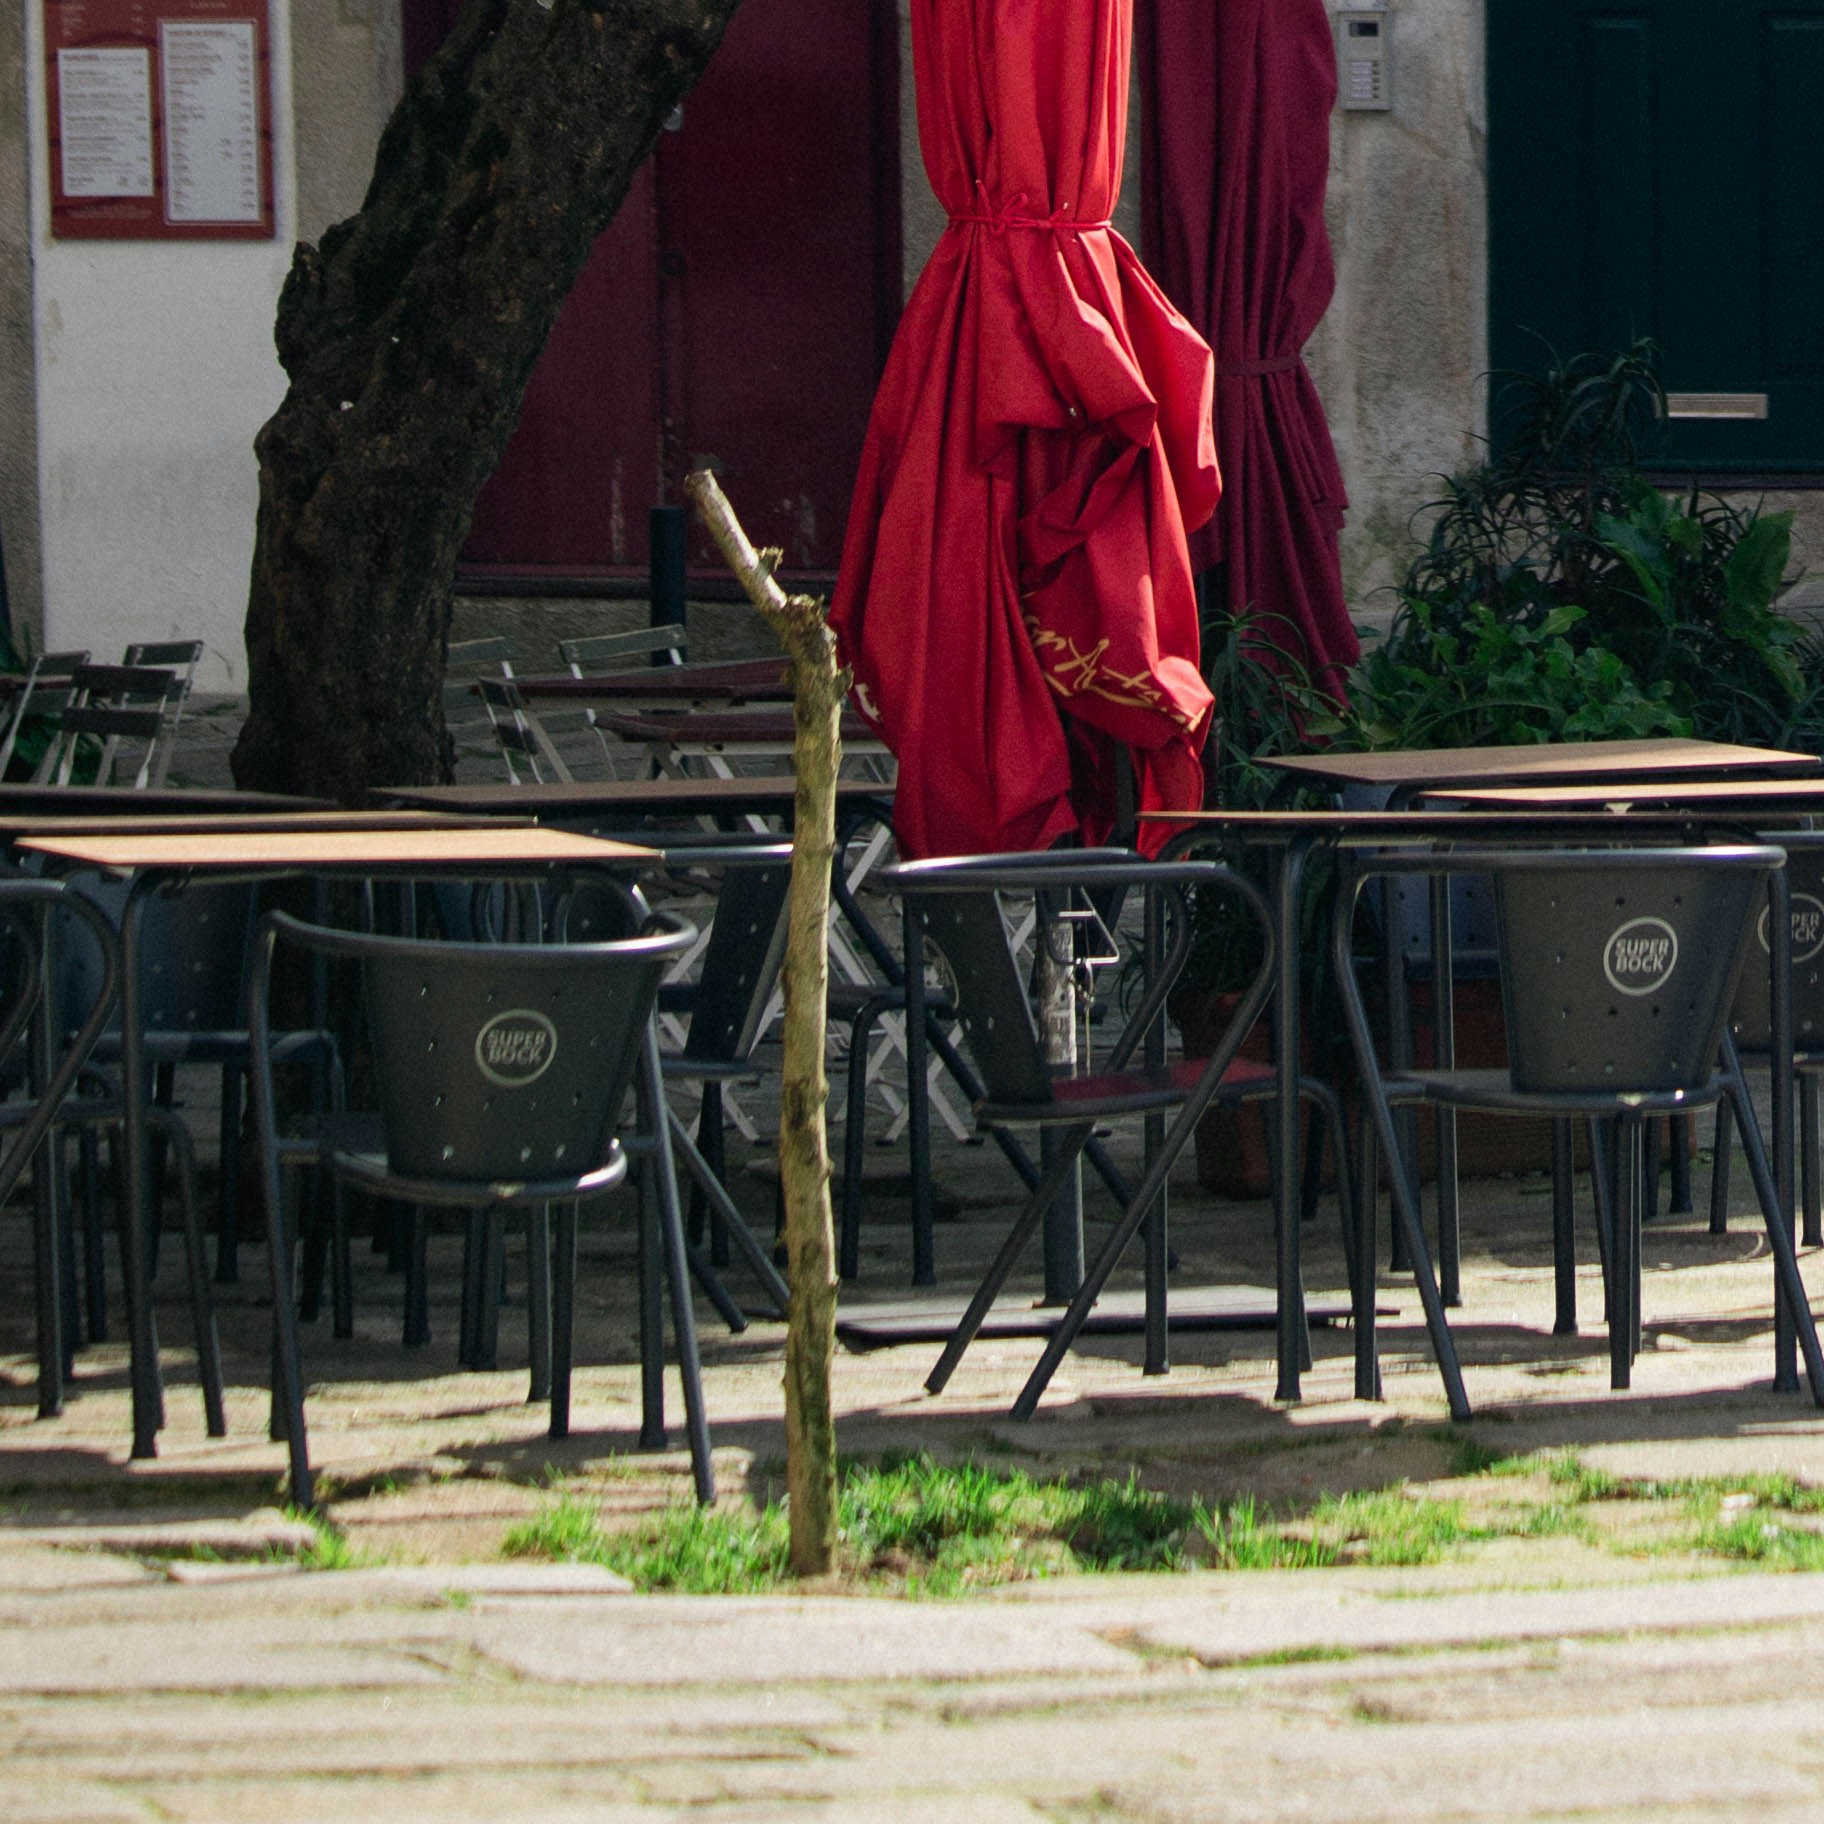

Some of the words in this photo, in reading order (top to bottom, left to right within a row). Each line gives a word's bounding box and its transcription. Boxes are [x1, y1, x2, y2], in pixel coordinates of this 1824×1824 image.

[1791, 911, 1820, 927] PER
[1615, 938, 1670, 958] SUPER
[1615, 954, 1664, 973] BOCK
[487, 1029, 546, 1049] SUPER
[488, 1046, 543, 1065] BOCK
